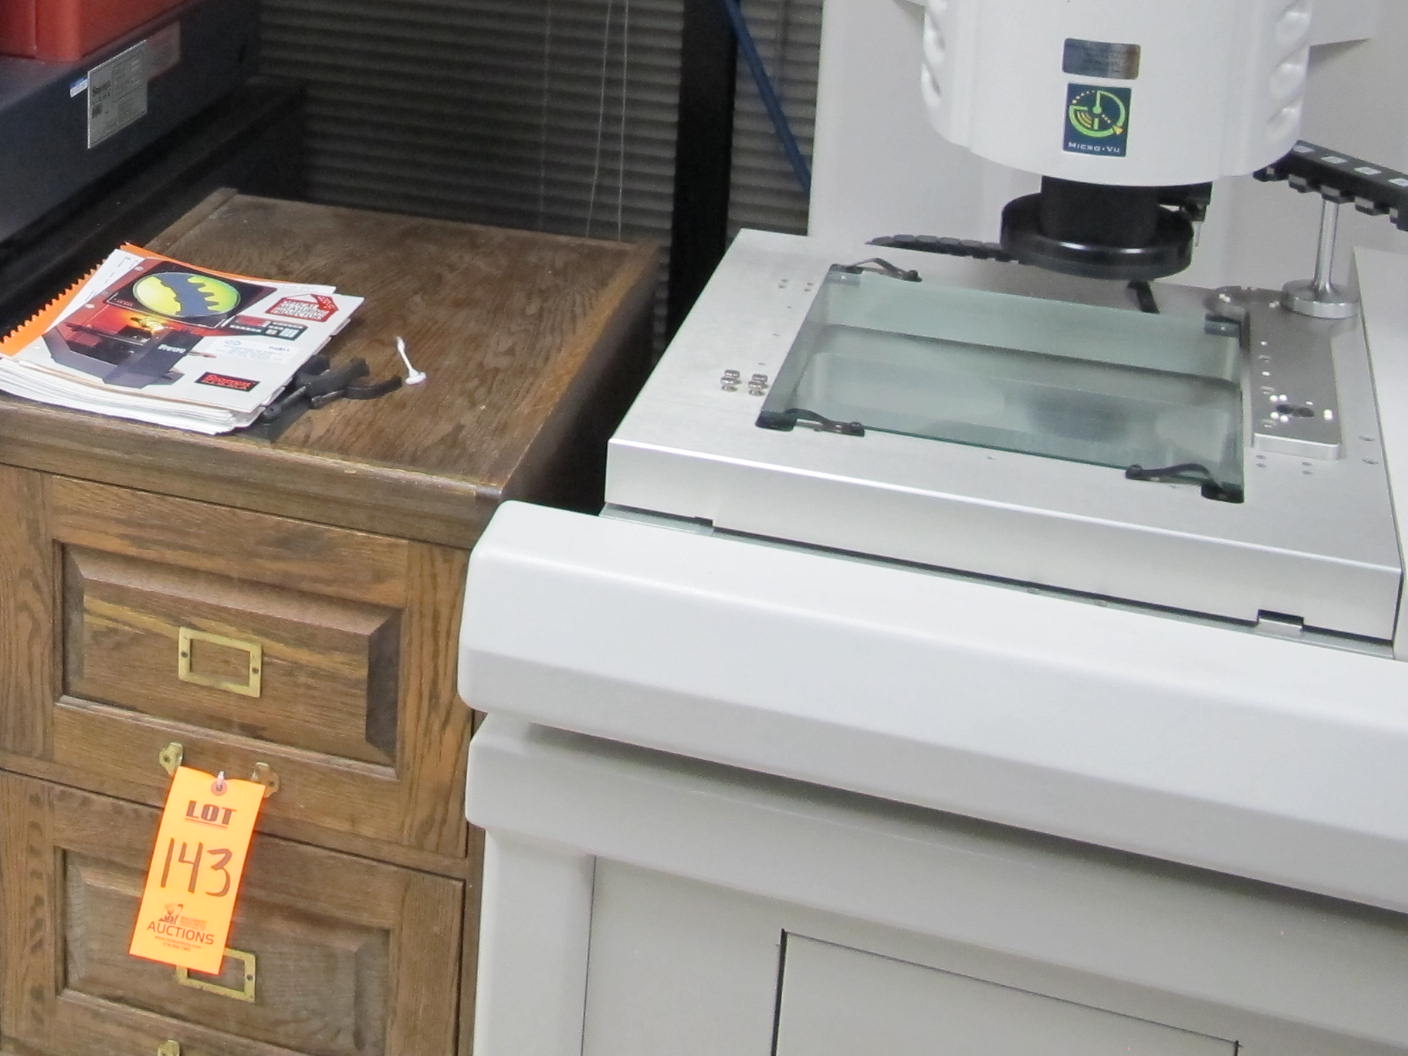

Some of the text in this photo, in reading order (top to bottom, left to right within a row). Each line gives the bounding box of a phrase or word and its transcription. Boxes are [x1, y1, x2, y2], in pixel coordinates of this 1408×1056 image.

[185, 800, 237, 826] LOT
[160, 837, 233, 898] 143
[147, 920, 216, 946] AUCTIONS
